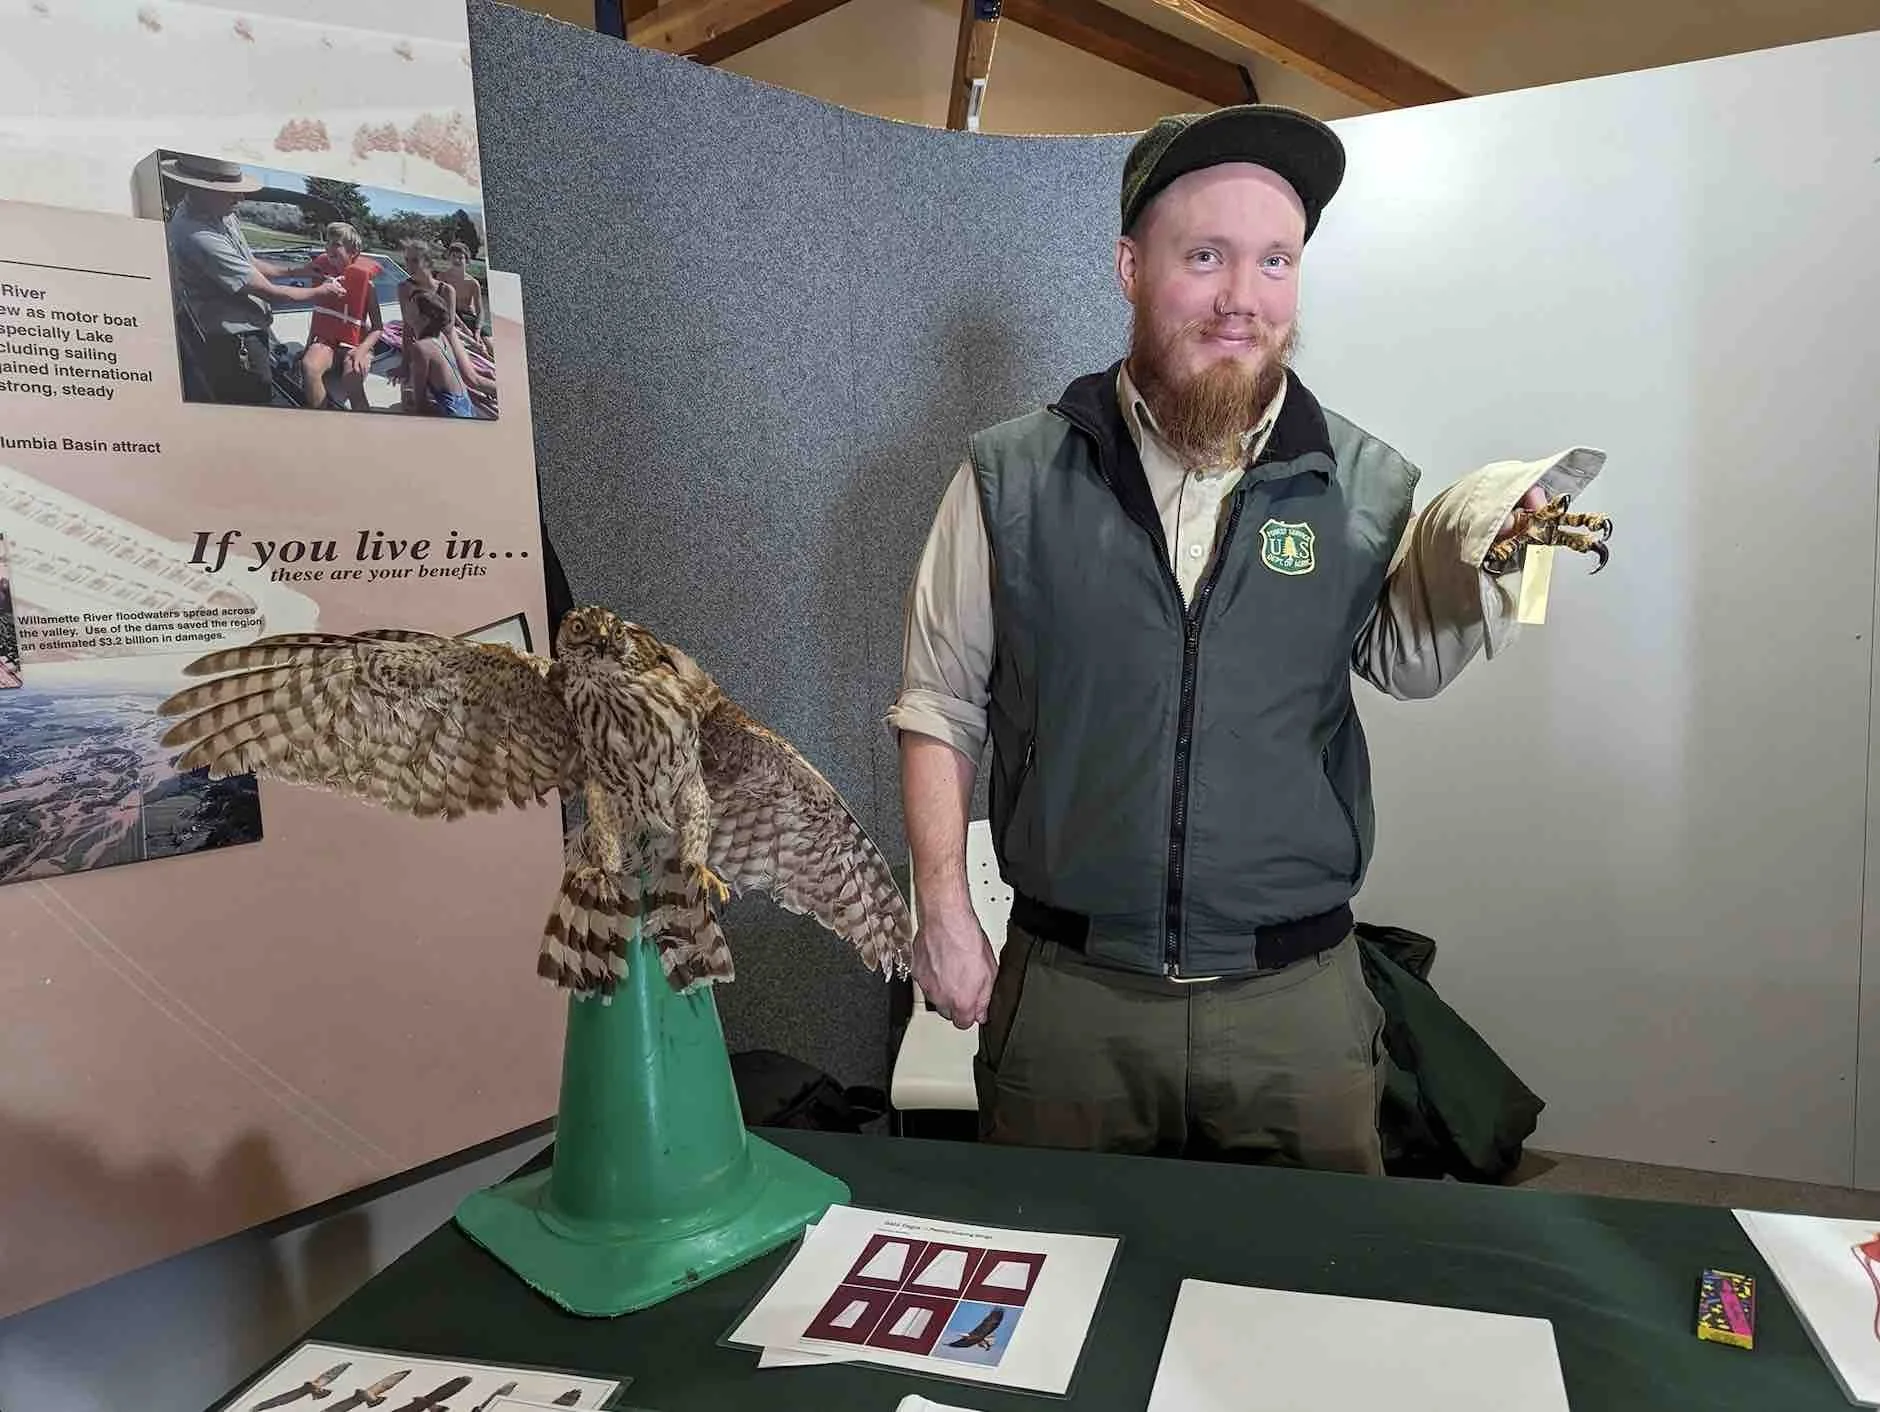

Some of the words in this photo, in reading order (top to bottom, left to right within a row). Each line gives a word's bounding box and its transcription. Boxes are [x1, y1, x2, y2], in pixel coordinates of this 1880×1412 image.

[2, 284, 46, 300] River
[26, 308, 46, 319] as
[51, 310, 98, 323] motor
[103, 313, 139, 327] boat
[76, 329, 114, 343] Lake
[65, 347, 118, 364] sailing
[0, 360, 49, 375] ained
[55, 363, 153, 382] international
[0, 380, 57, 397] strong,
[62, 384, 114, 401] steady
[62, 438, 108, 452] Basin
[112, 441, 161, 454] attract
[187, 530, 242, 573] If
[247, 540, 338, 572] you
[355, 529, 431, 561] live
[446, 530, 529, 560] in...
[1269, 538, 1282, 555] U
[1299, 541, 1310, 559] S
[270, 567, 324, 582] these
[330, 569, 362, 580] are
[367, 567, 413, 583] your
[418, 563, 488, 580] benefits
[18, 615, 80, 625] Willamette
[83, 612, 113, 622] River
[115, 609, 180, 621] floodwaters
[183, 608, 219, 619] spread
[221, 607, 256, 616] across
[19, 629, 39, 638] the
[41, 627, 79, 638] valley.
[85, 625, 107, 635] Use
[110, 624, 121, 634] of
[124, 623, 142, 633] the
[144, 621, 175, 632] dams
[177, 619, 209, 630] saved
[211, 619, 228, 628] the
[230, 617, 263, 629] region
[20, 643, 36, 652] an
[39, 638, 96, 650] estimated
[99, 636, 122, 647] $3.2
[125, 634, 160, 645] billion
[161, 634, 173, 643] in
[175, 631, 226, 643] damages.
